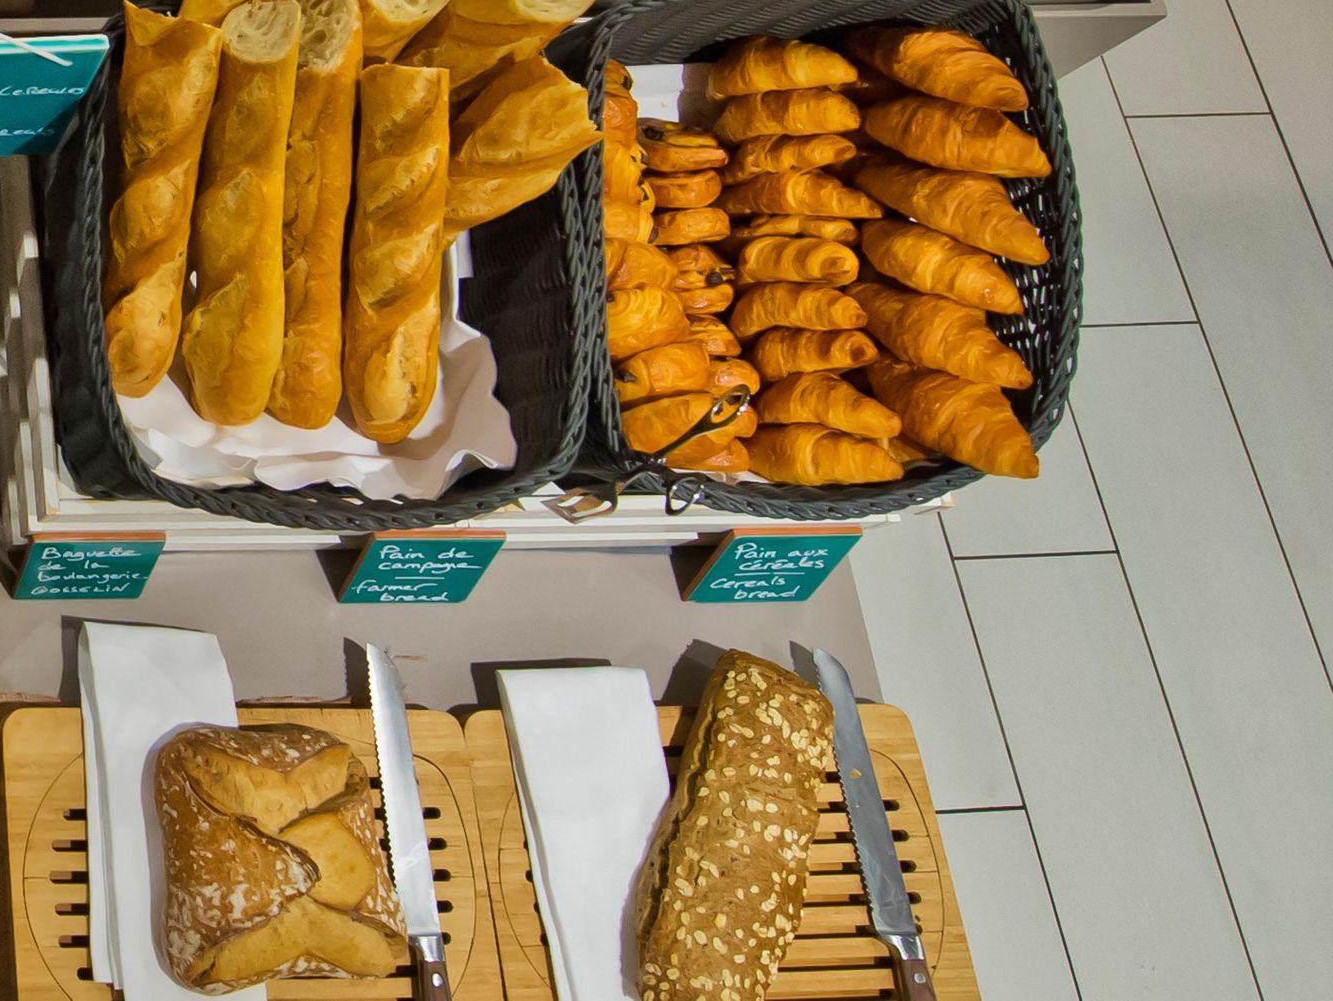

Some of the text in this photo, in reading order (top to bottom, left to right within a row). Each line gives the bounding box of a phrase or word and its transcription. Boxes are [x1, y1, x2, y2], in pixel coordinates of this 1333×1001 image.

[41, 547, 142, 562] Baguette
[378, 544, 474, 559] Pain de
[734, 542, 829, 560] Pain aux
[37, 560, 110, 571] de la
[379, 592, 449, 602] bread
[734, 585, 800, 600] bread
